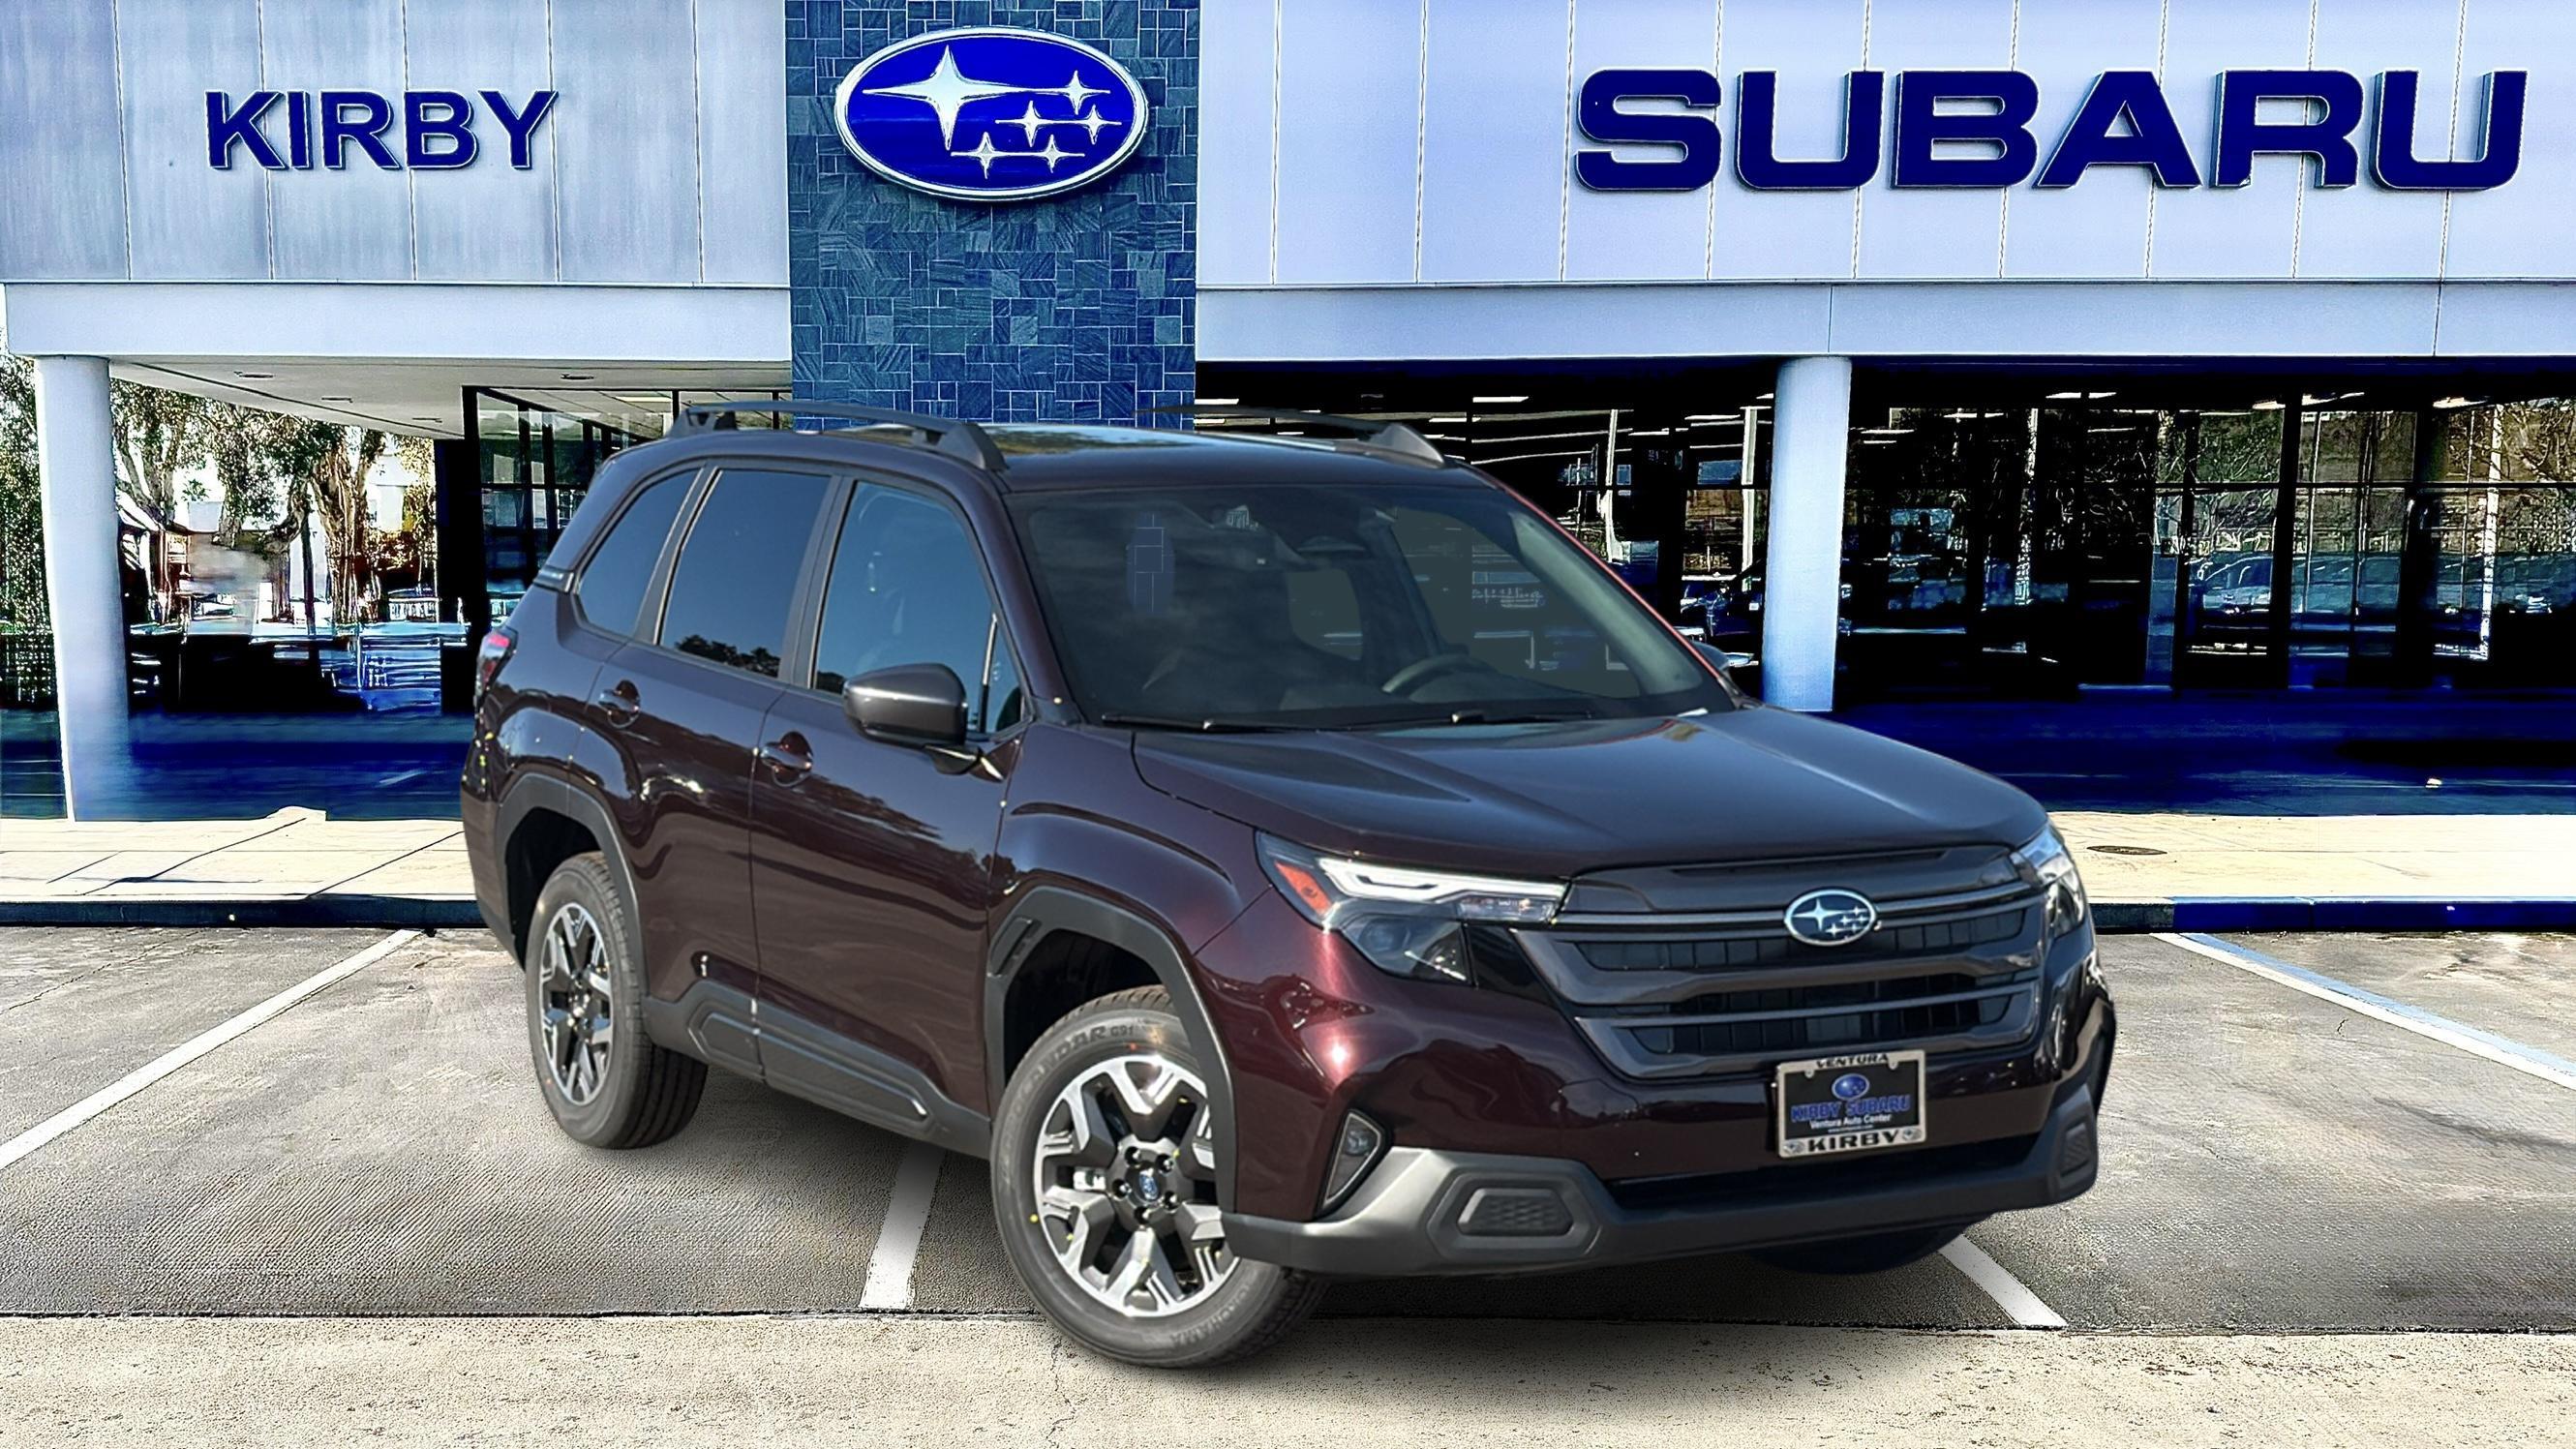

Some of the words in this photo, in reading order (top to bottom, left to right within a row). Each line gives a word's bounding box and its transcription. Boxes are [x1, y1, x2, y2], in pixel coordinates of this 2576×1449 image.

[204, 90, 559, 171] KIRBY
[1574, 69, 2529, 193] SUBARU
[1816, 1054, 1888, 1068] VENTURA
[1791, 1102, 1842, 1123] KIRBY
[1845, 1095, 1911, 1116] SUBARU
[1809, 1120, 1841, 1130] Ventura
[1843, 1116, 1862, 1125] Auto
[1864, 1114, 1892, 1124] Center
[1809, 1130, 1898, 1152] KIRBY
